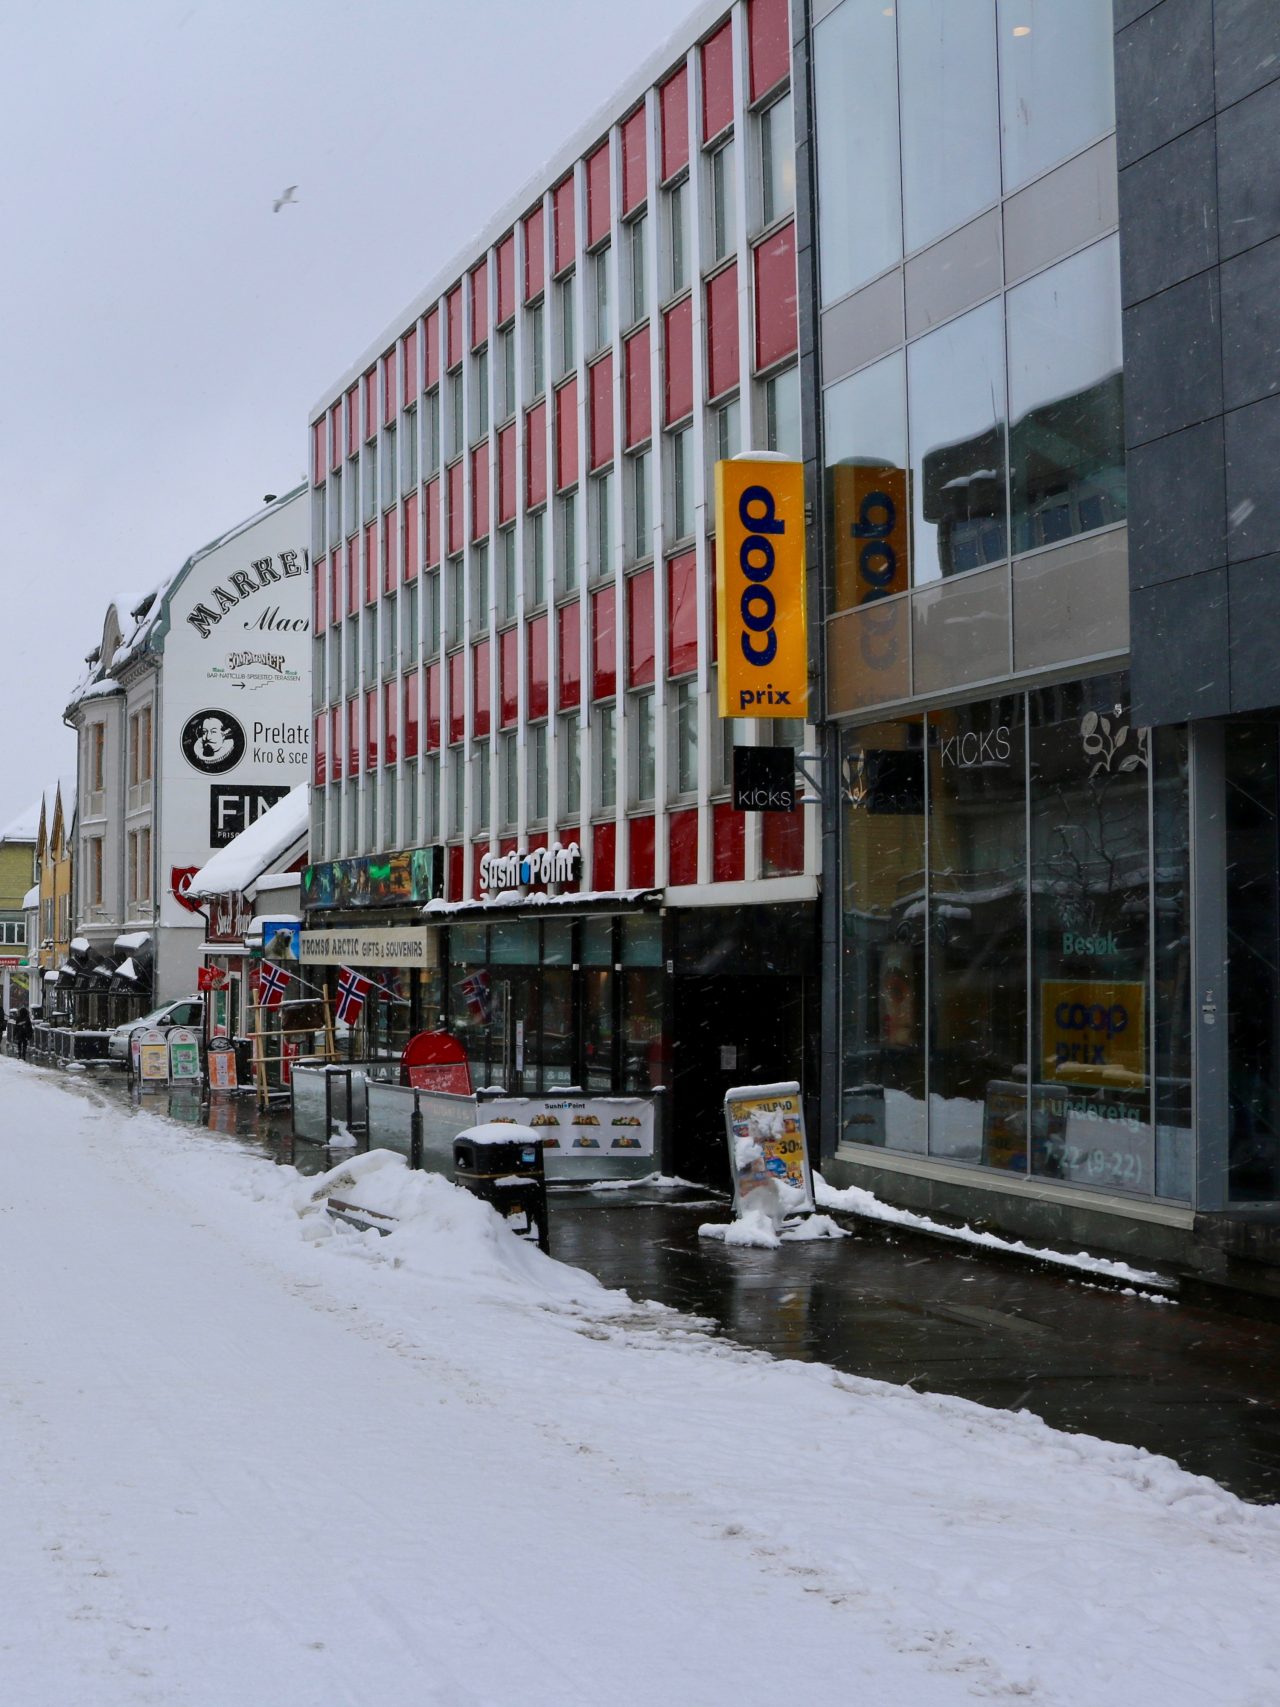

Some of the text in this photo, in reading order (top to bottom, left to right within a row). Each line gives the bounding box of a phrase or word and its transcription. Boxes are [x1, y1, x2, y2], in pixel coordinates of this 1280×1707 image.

[739, 485, 785, 667] coop
[740, 684, 791, 710] prix
[253, 748, 273, 764] Kro
[277, 748, 285, 764] &
[941, 726, 1011, 769] KICKS
[739, 790, 791, 807] KICKS
[480, 847, 573, 889] Sushi Point
[302, 938, 329, 956] TROMSØ
[332, 938, 359, 956] ARCTIC
[361, 942, 379, 957] GIFTS
[386, 941, 423, 957] SOUVENIRS
[1062, 930, 1118, 955] Besøk
[1055, 1002, 1128, 1040] coop
